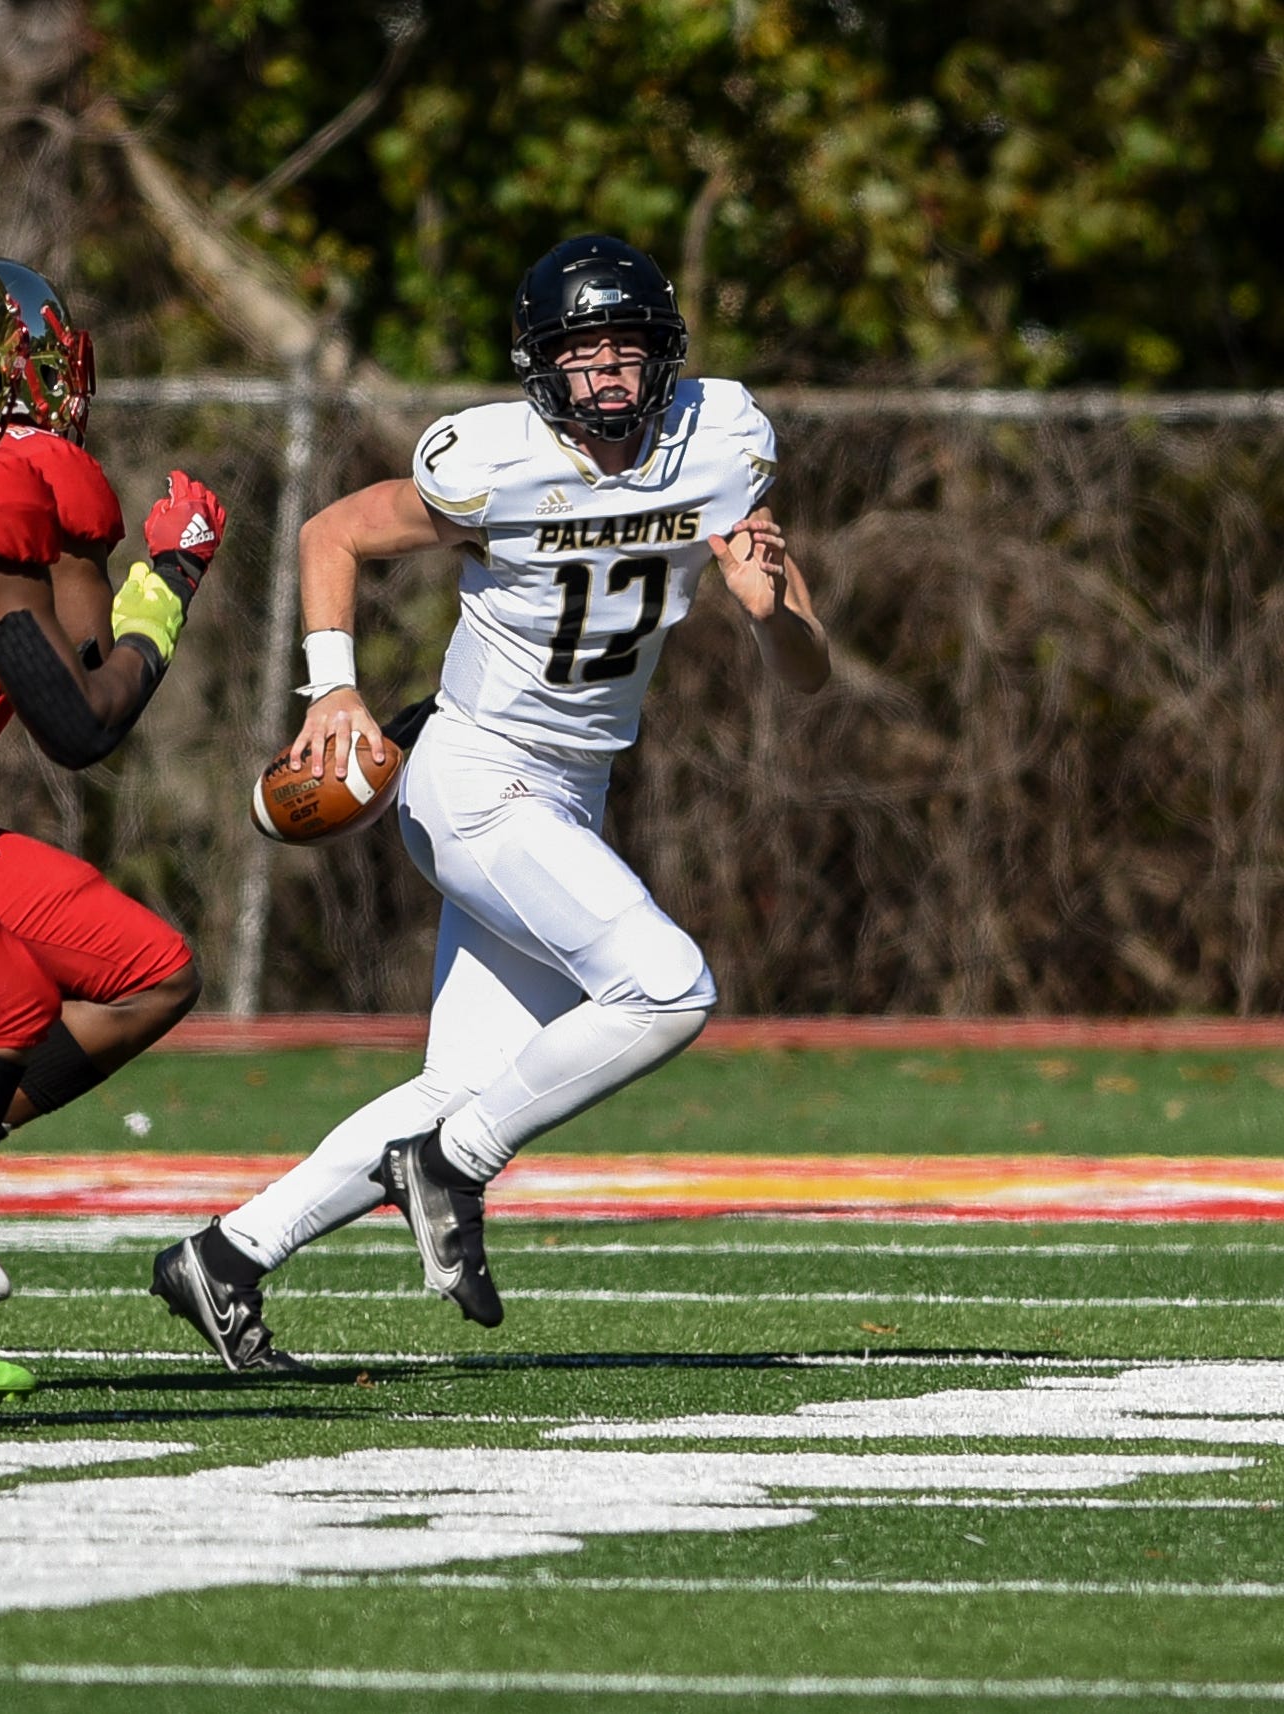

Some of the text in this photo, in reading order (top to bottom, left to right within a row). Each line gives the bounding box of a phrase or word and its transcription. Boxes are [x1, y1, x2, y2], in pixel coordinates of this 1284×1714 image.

[535, 503, 573, 516] adidas
[180, 531, 215, 549] adidas
[536, 511, 701, 553] PALADINS
[543, 556, 670, 686] 12
